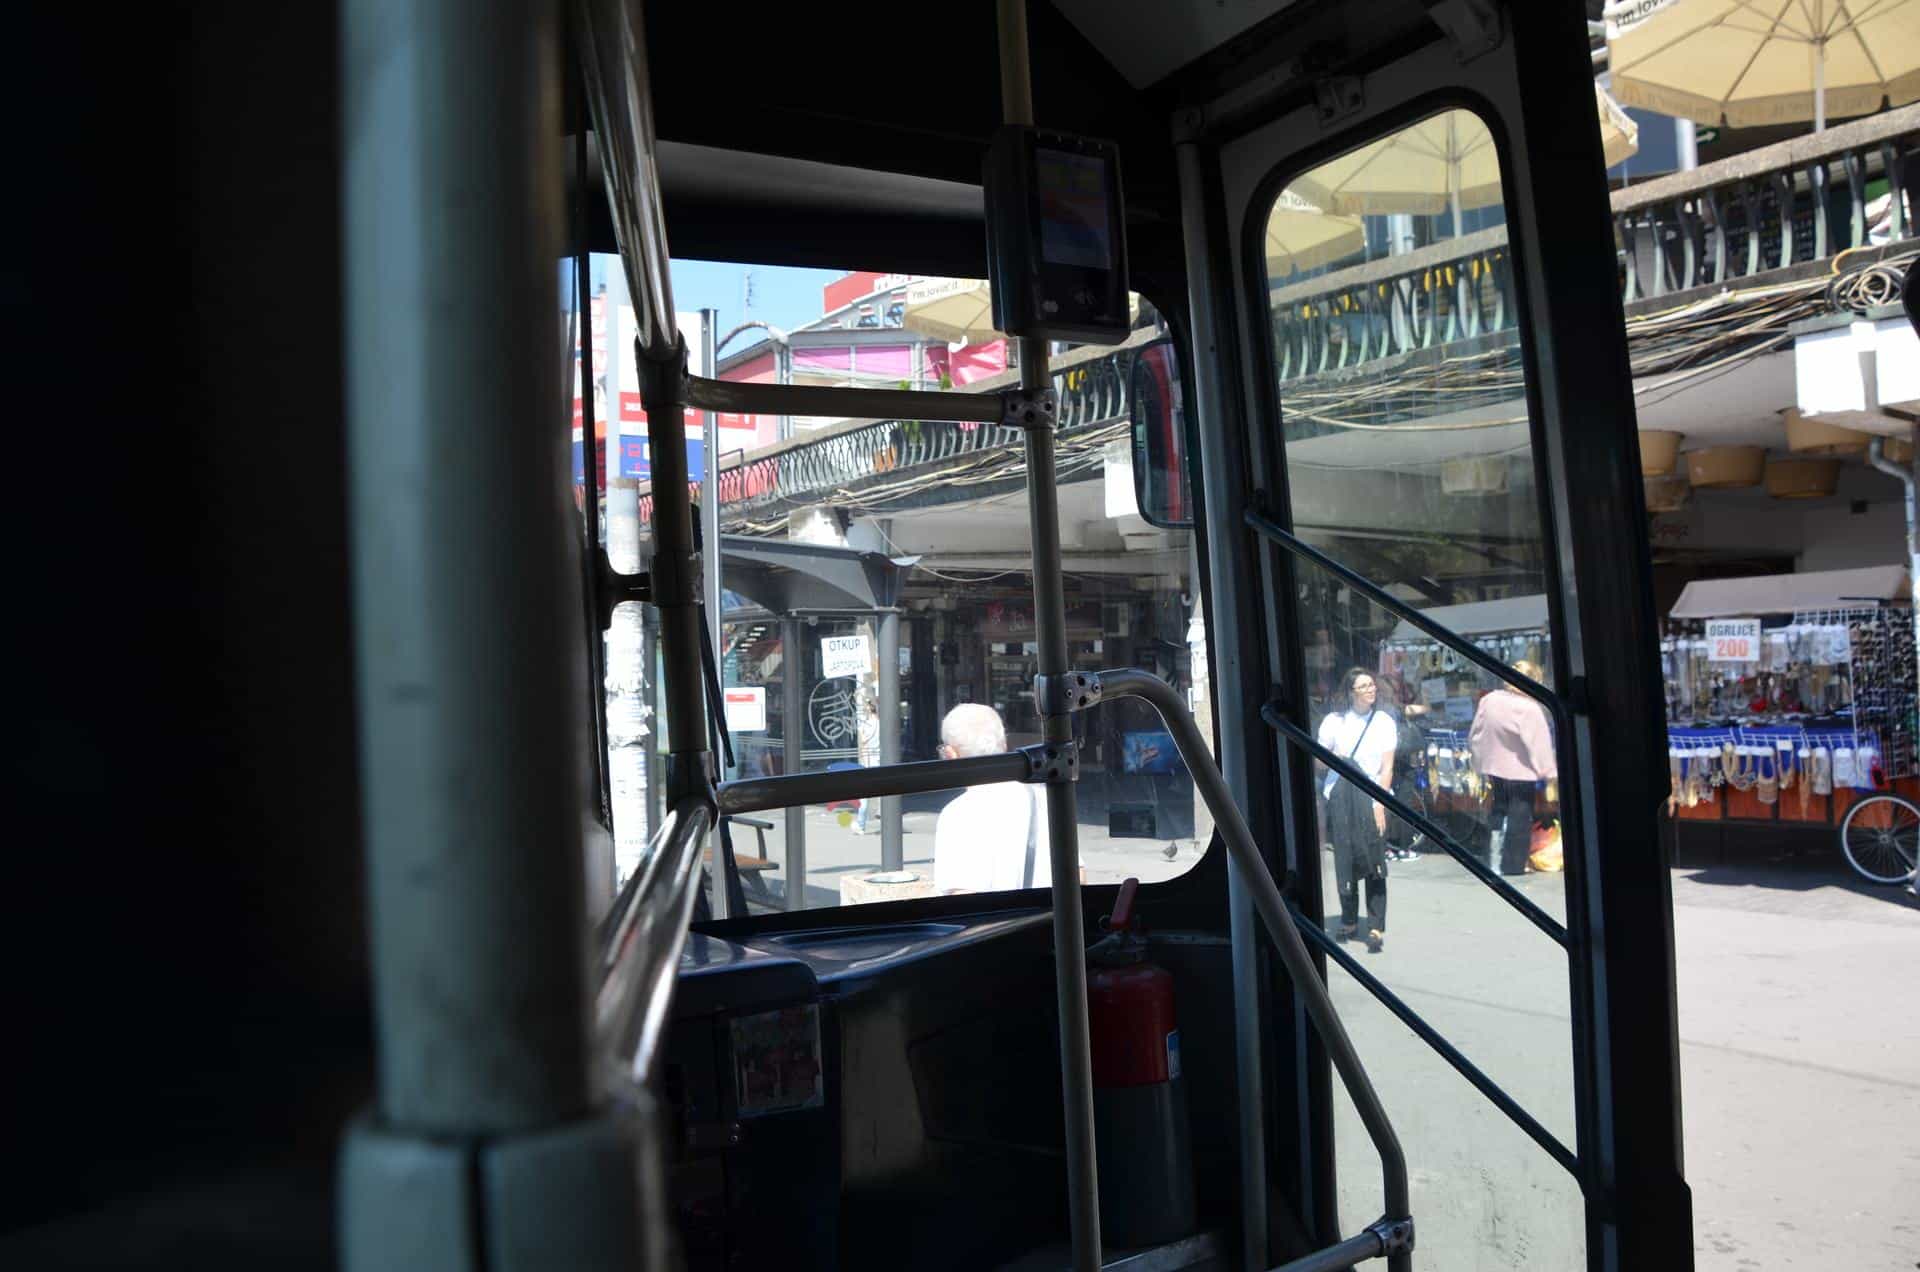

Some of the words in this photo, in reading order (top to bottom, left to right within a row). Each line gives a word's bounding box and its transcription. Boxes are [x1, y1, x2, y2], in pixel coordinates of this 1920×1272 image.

[1710, 624, 1757, 636] OGRLICE
[829, 638, 861, 651] OTKUP
[1716, 639, 1749, 656] 200
